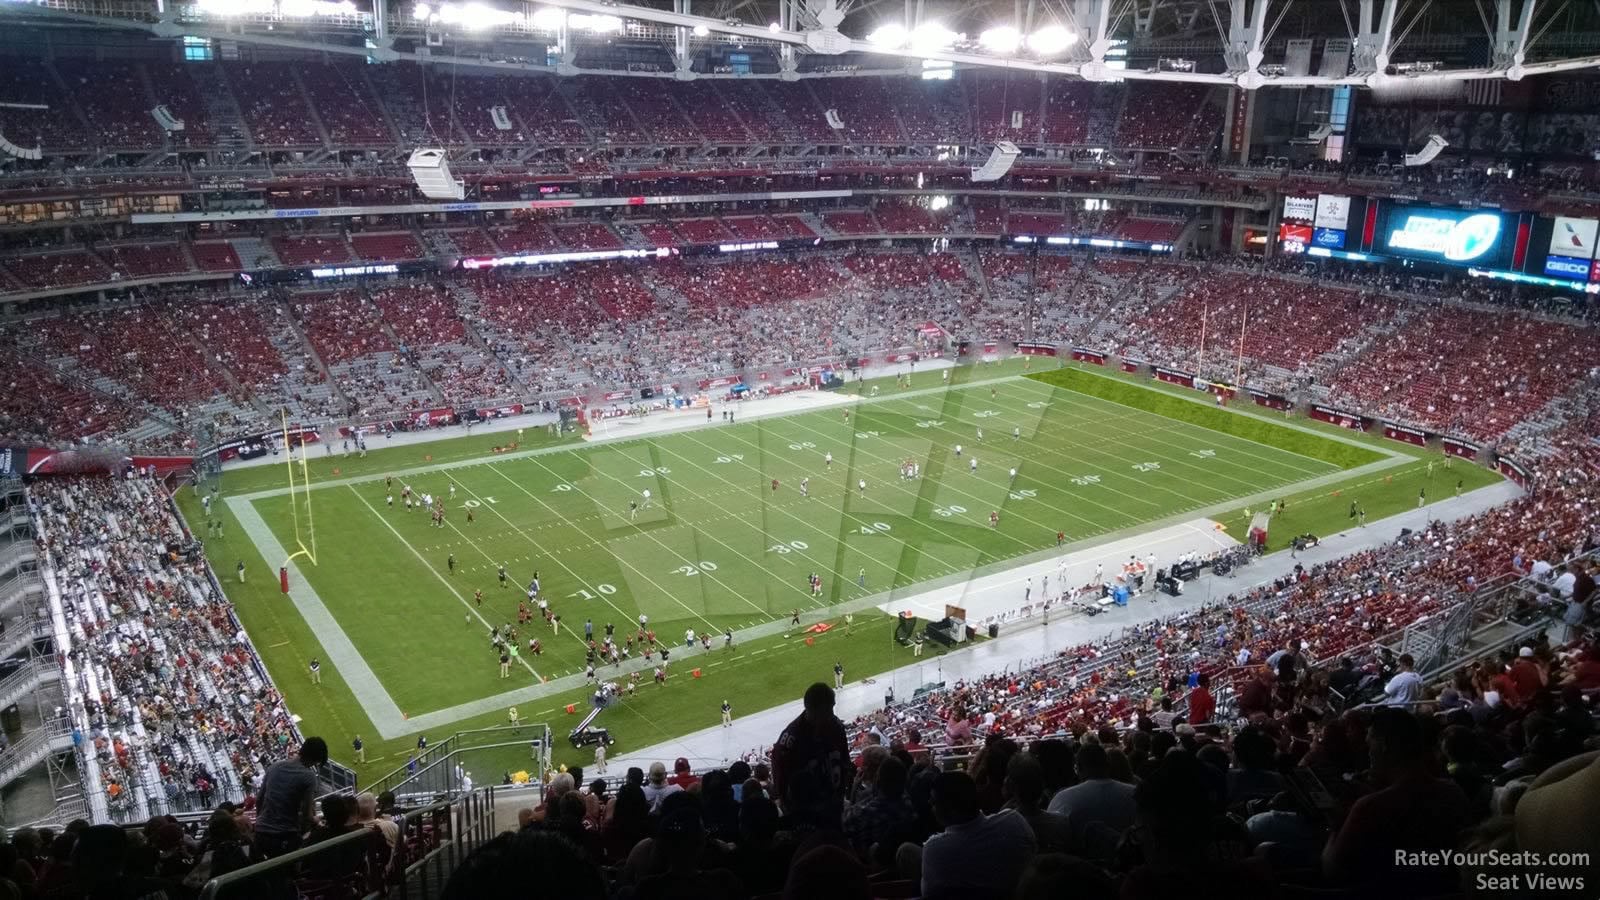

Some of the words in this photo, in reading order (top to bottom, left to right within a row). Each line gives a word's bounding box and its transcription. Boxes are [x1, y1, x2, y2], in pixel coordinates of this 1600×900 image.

[1546, 261, 1588, 274] GEICO
[936, 505, 968, 517] 50
[860, 521, 892, 535] 40
[771, 540, 809, 555] 30
[678, 560, 718, 578] 20
[574, 583, 618, 601] 10
